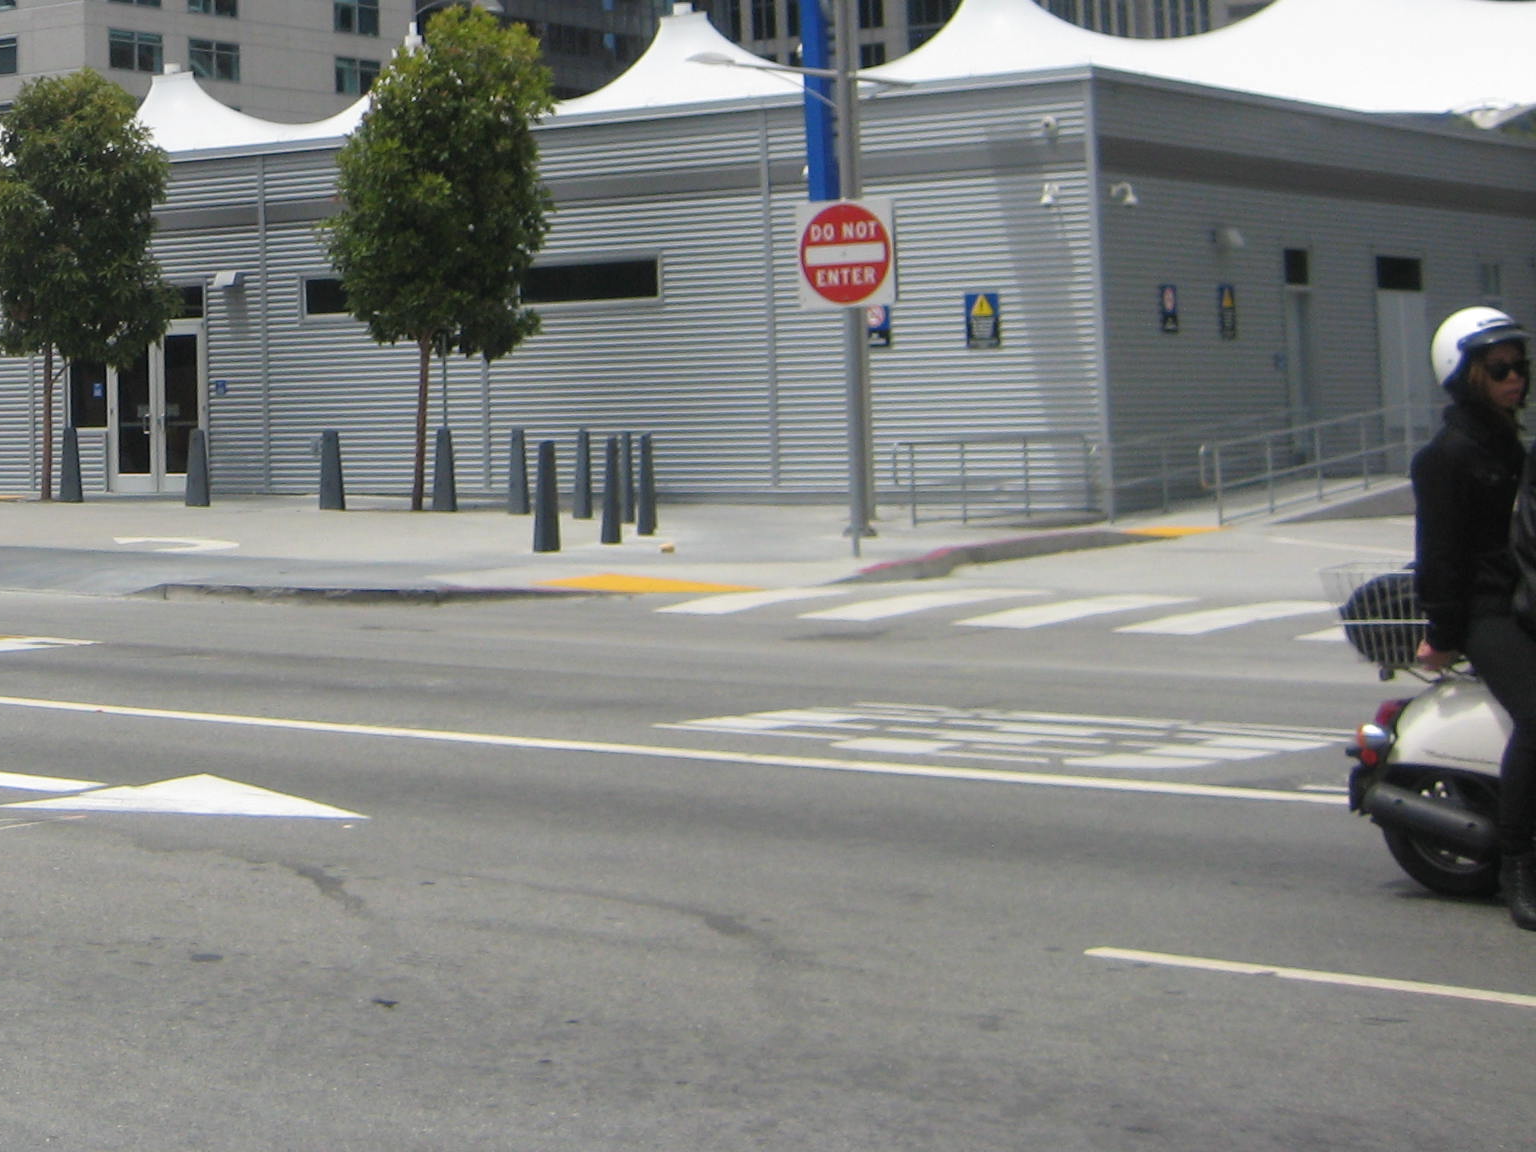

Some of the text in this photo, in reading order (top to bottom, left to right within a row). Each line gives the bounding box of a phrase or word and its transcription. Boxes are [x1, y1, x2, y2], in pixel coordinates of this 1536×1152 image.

[810, 220, 878, 242] DO NOT
[815, 266, 877, 288] ENTER
